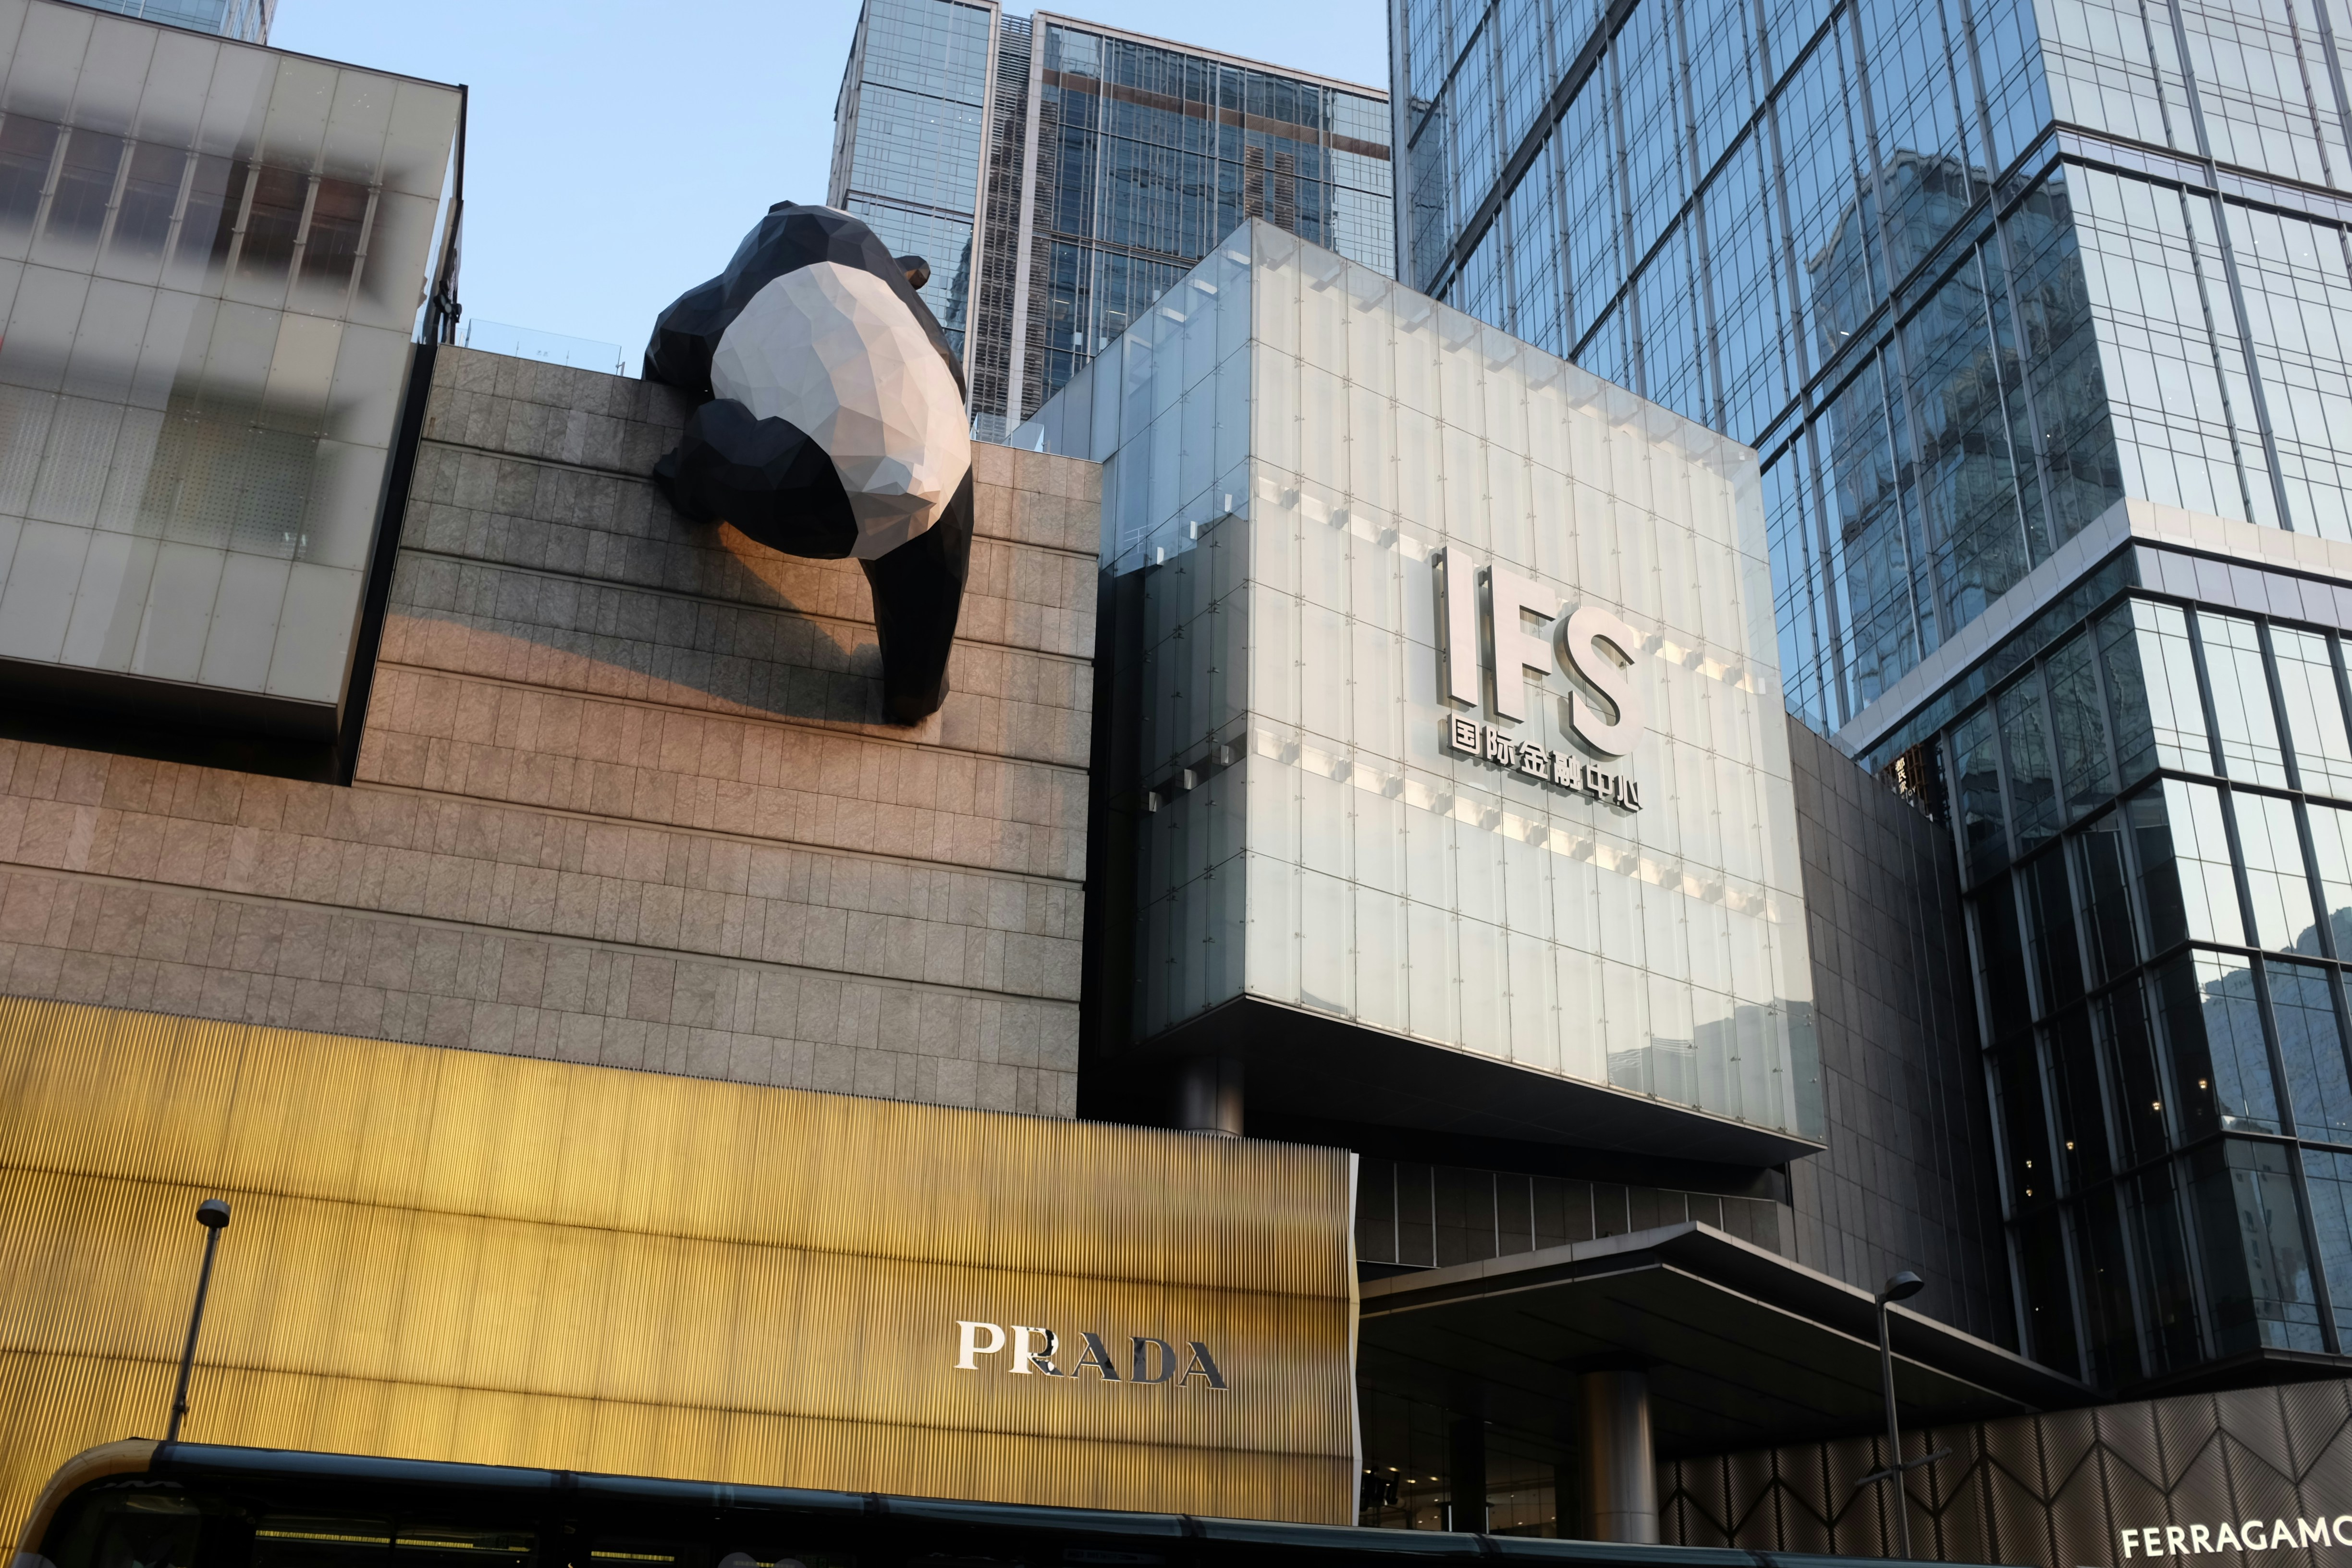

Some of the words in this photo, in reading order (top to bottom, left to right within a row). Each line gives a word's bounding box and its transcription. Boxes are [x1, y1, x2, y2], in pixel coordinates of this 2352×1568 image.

[1443, 546, 1644, 756] IFS
[1447, 713, 1643, 812] 国际金融中心
[954, 1320, 1229, 1391] PRADA
[2121, 1515, 2352, 1558] FERRAGAMO
